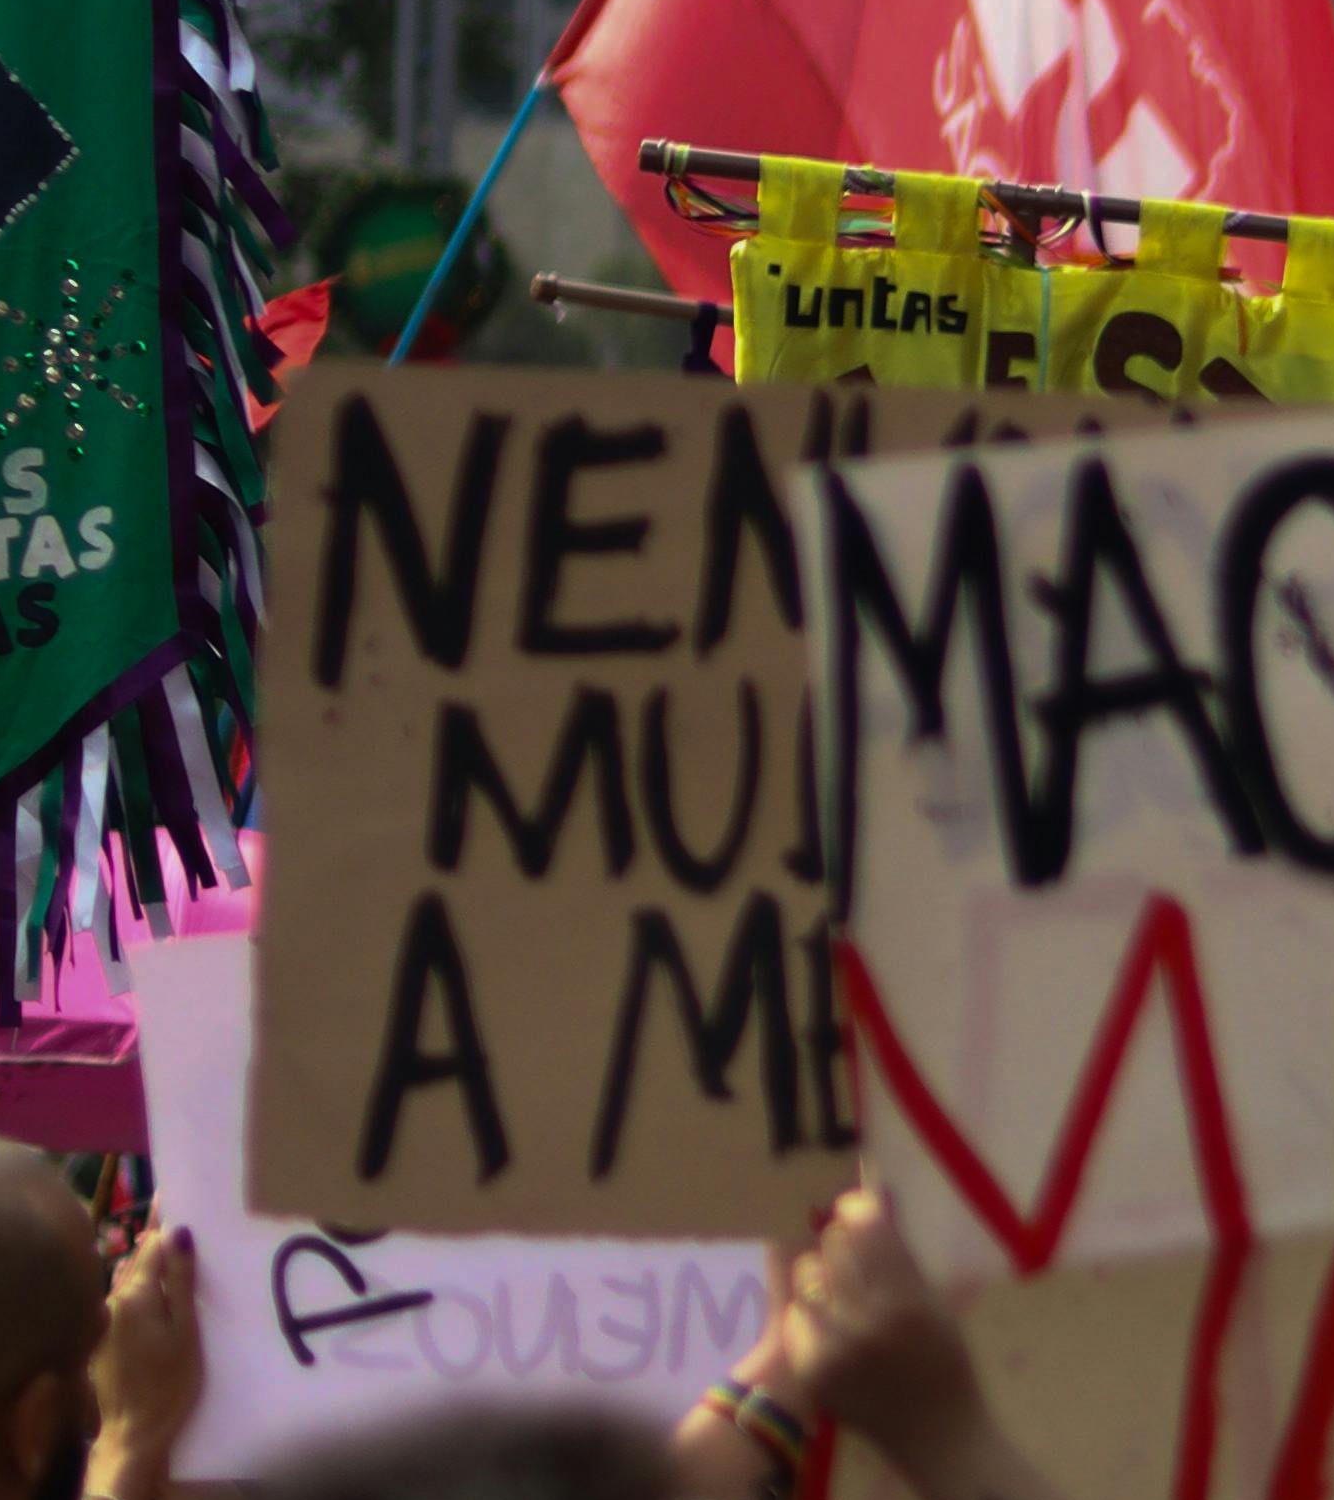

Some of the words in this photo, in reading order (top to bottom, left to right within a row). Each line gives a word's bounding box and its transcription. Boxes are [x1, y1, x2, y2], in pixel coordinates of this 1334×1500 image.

[767, 263, 968, 335] untas
[355, 888, 513, 1186] A
[588, 886, 862, 1186] ME
